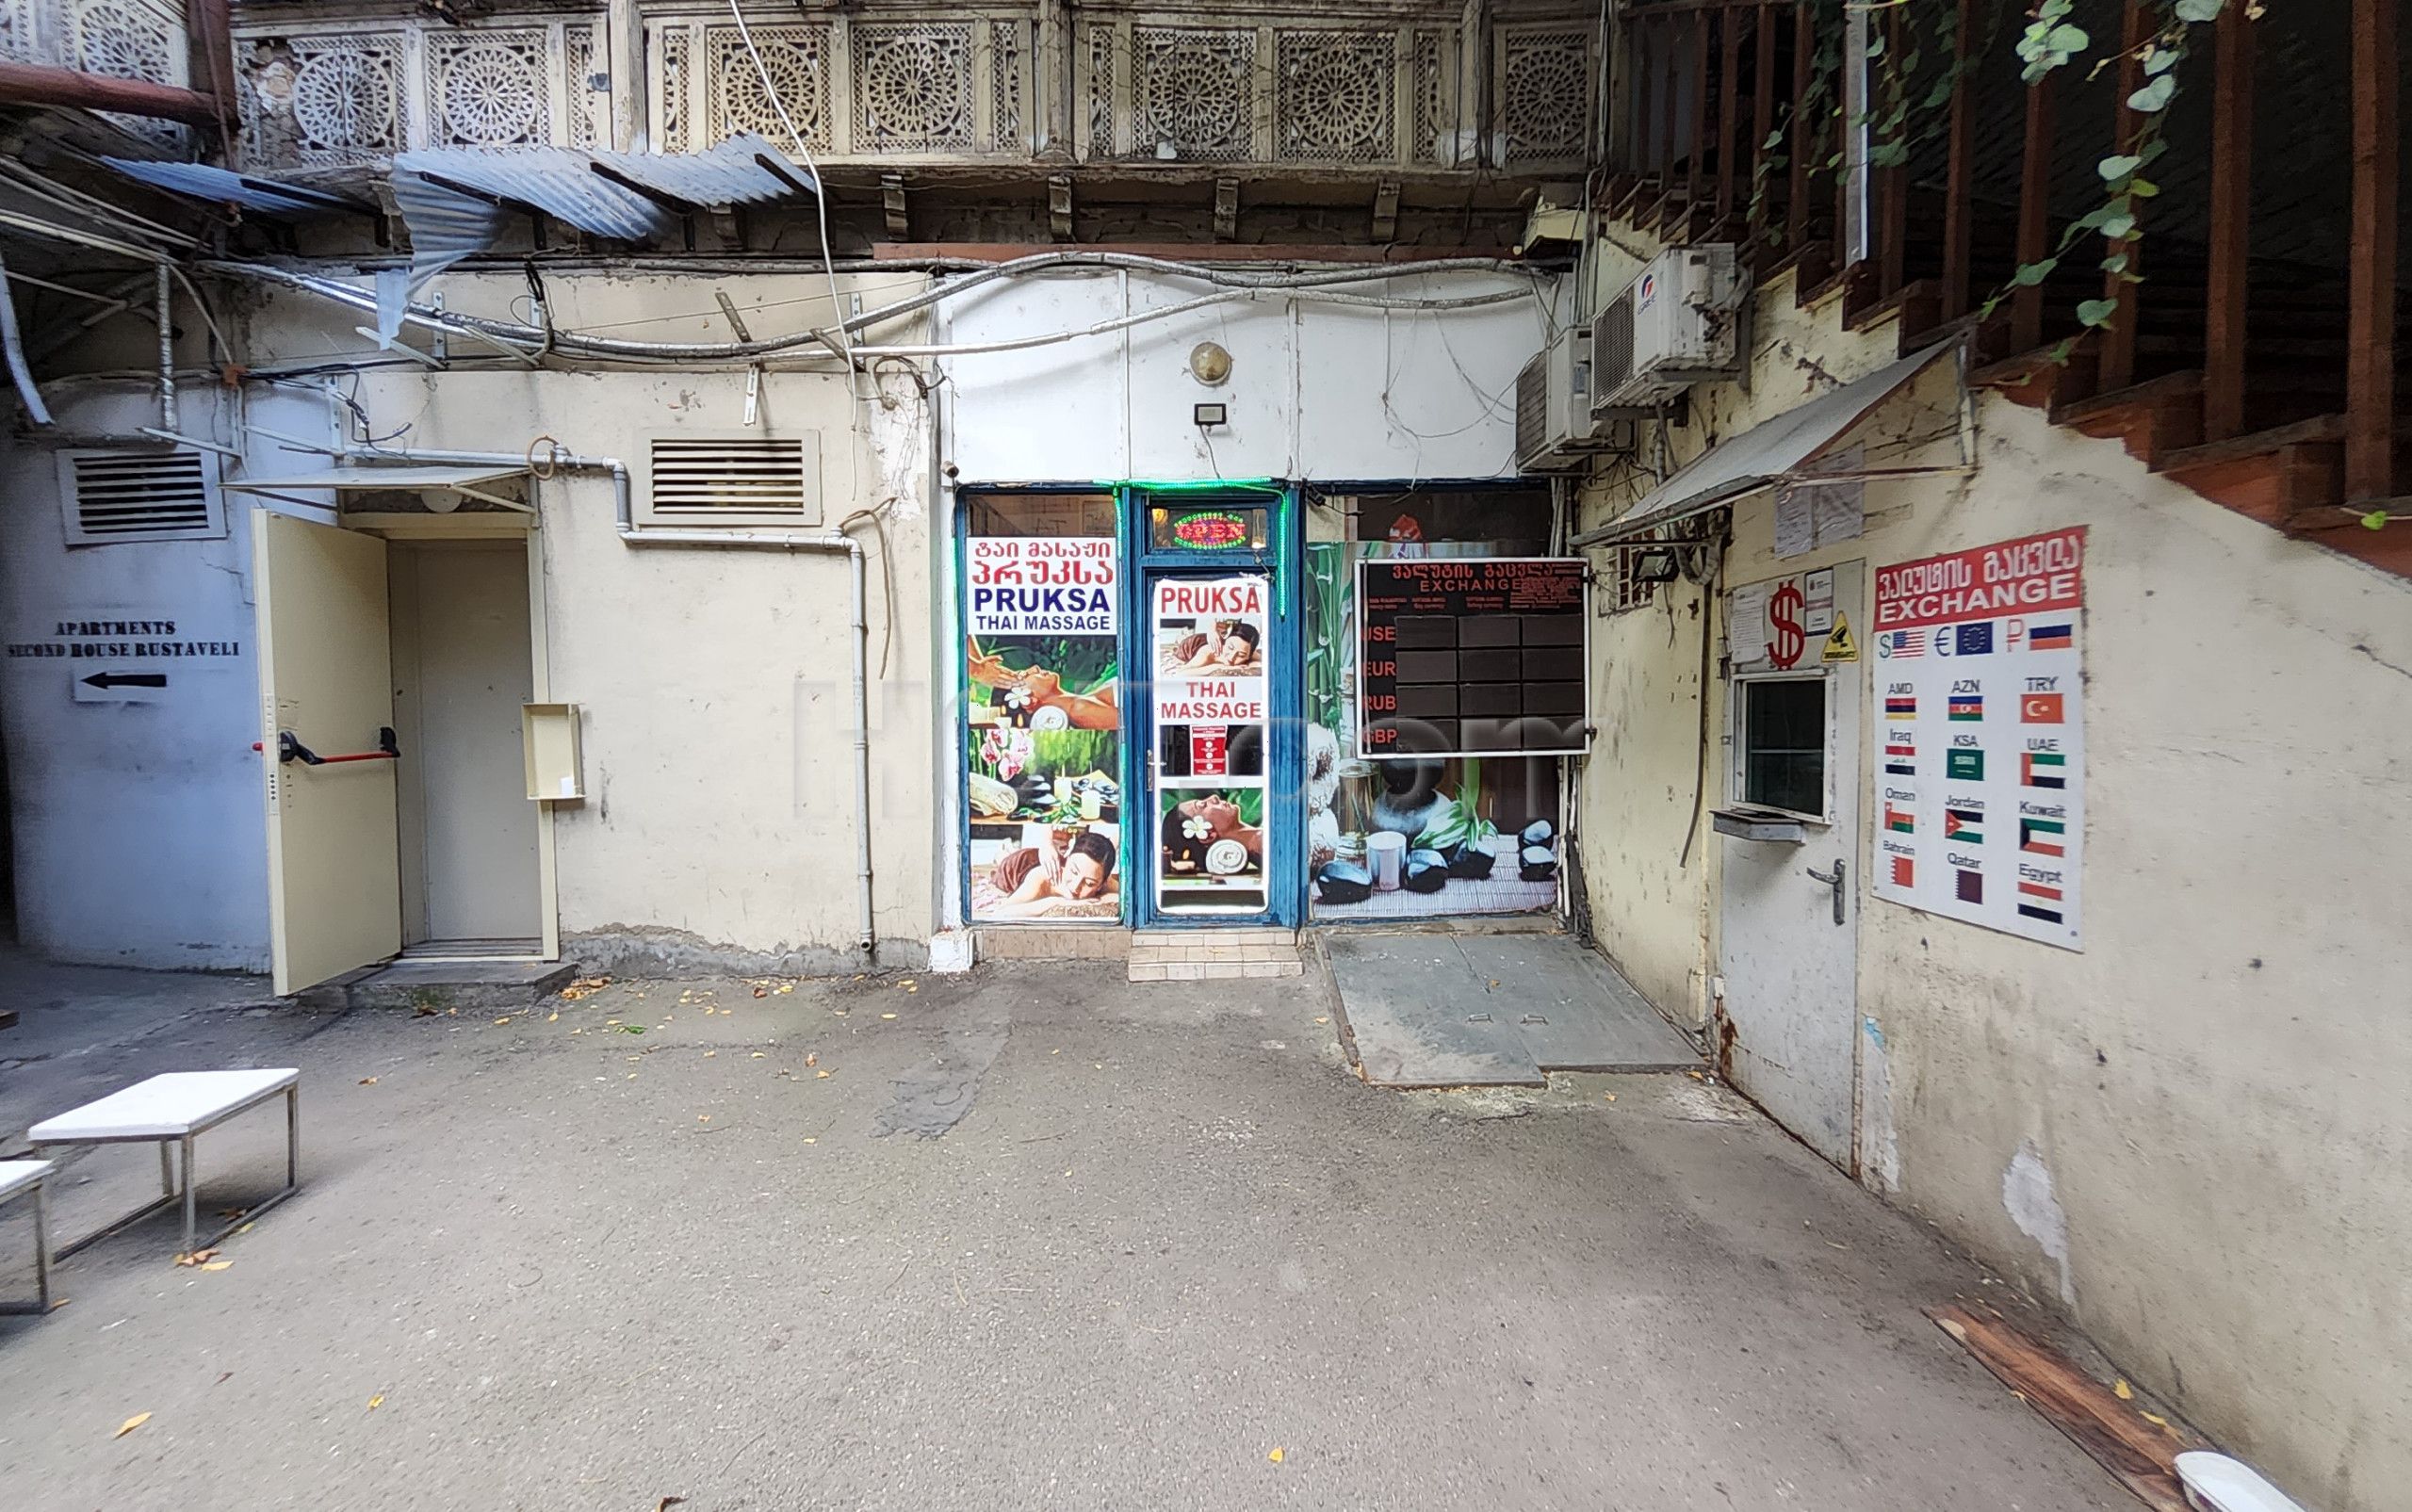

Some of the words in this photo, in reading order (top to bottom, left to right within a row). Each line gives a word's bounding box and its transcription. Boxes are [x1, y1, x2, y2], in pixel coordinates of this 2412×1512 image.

[1175, 523, 1247, 540] OPEN
[975, 542, 1019, 558] ტაი
[1028, 542, 1111, 558] მასაჟი
[1393, 564, 1474, 579] ვალუტის
[1879, 557, 1973, 601] ვალუტის
[1983, 534, 2080, 584] გაცვლა
[1420, 577, 1523, 593] EXCHANGE
[974, 588, 1111, 612] PRUKSA
[1161, 586, 1262, 613] PRUKSA
[1878, 573, 2078, 623] EXCHANGE
[55, 621, 176, 635] APARTMENTS
[976, 615, 1019, 630] THAI
[1024, 615, 1111, 630] MASSAGE
[8, 643, 65, 658] SECOND
[70, 642, 129, 658] HOUSE
[135, 642, 239, 657] RUSTAVELI
[1362, 661, 1396, 676] EUR
[1185, 681, 1236, 699] THAI
[1888, 682, 1914, 694] AMD
[1951, 679, 1980, 693] AZN
[2025, 676, 2059, 691] TRY
[1161, 702, 1262, 719] MASSAGE
[1362, 695, 1396, 710] RUB
[1362, 728, 1397, 743] GBP
[1890, 728, 1912, 744] Iraq
[1953, 735, 1979, 747] KSA
[2027, 739, 2059, 751] UAE
[1885, 788, 1915, 801] Oman
[1945, 795, 1984, 809] Jordan
[2019, 801, 2066, 818] Kuwait
[1883, 840, 1915, 855] Bahrain
[1948, 853, 1981, 869] Qatar
[2019, 863, 2062, 884] Egypt
